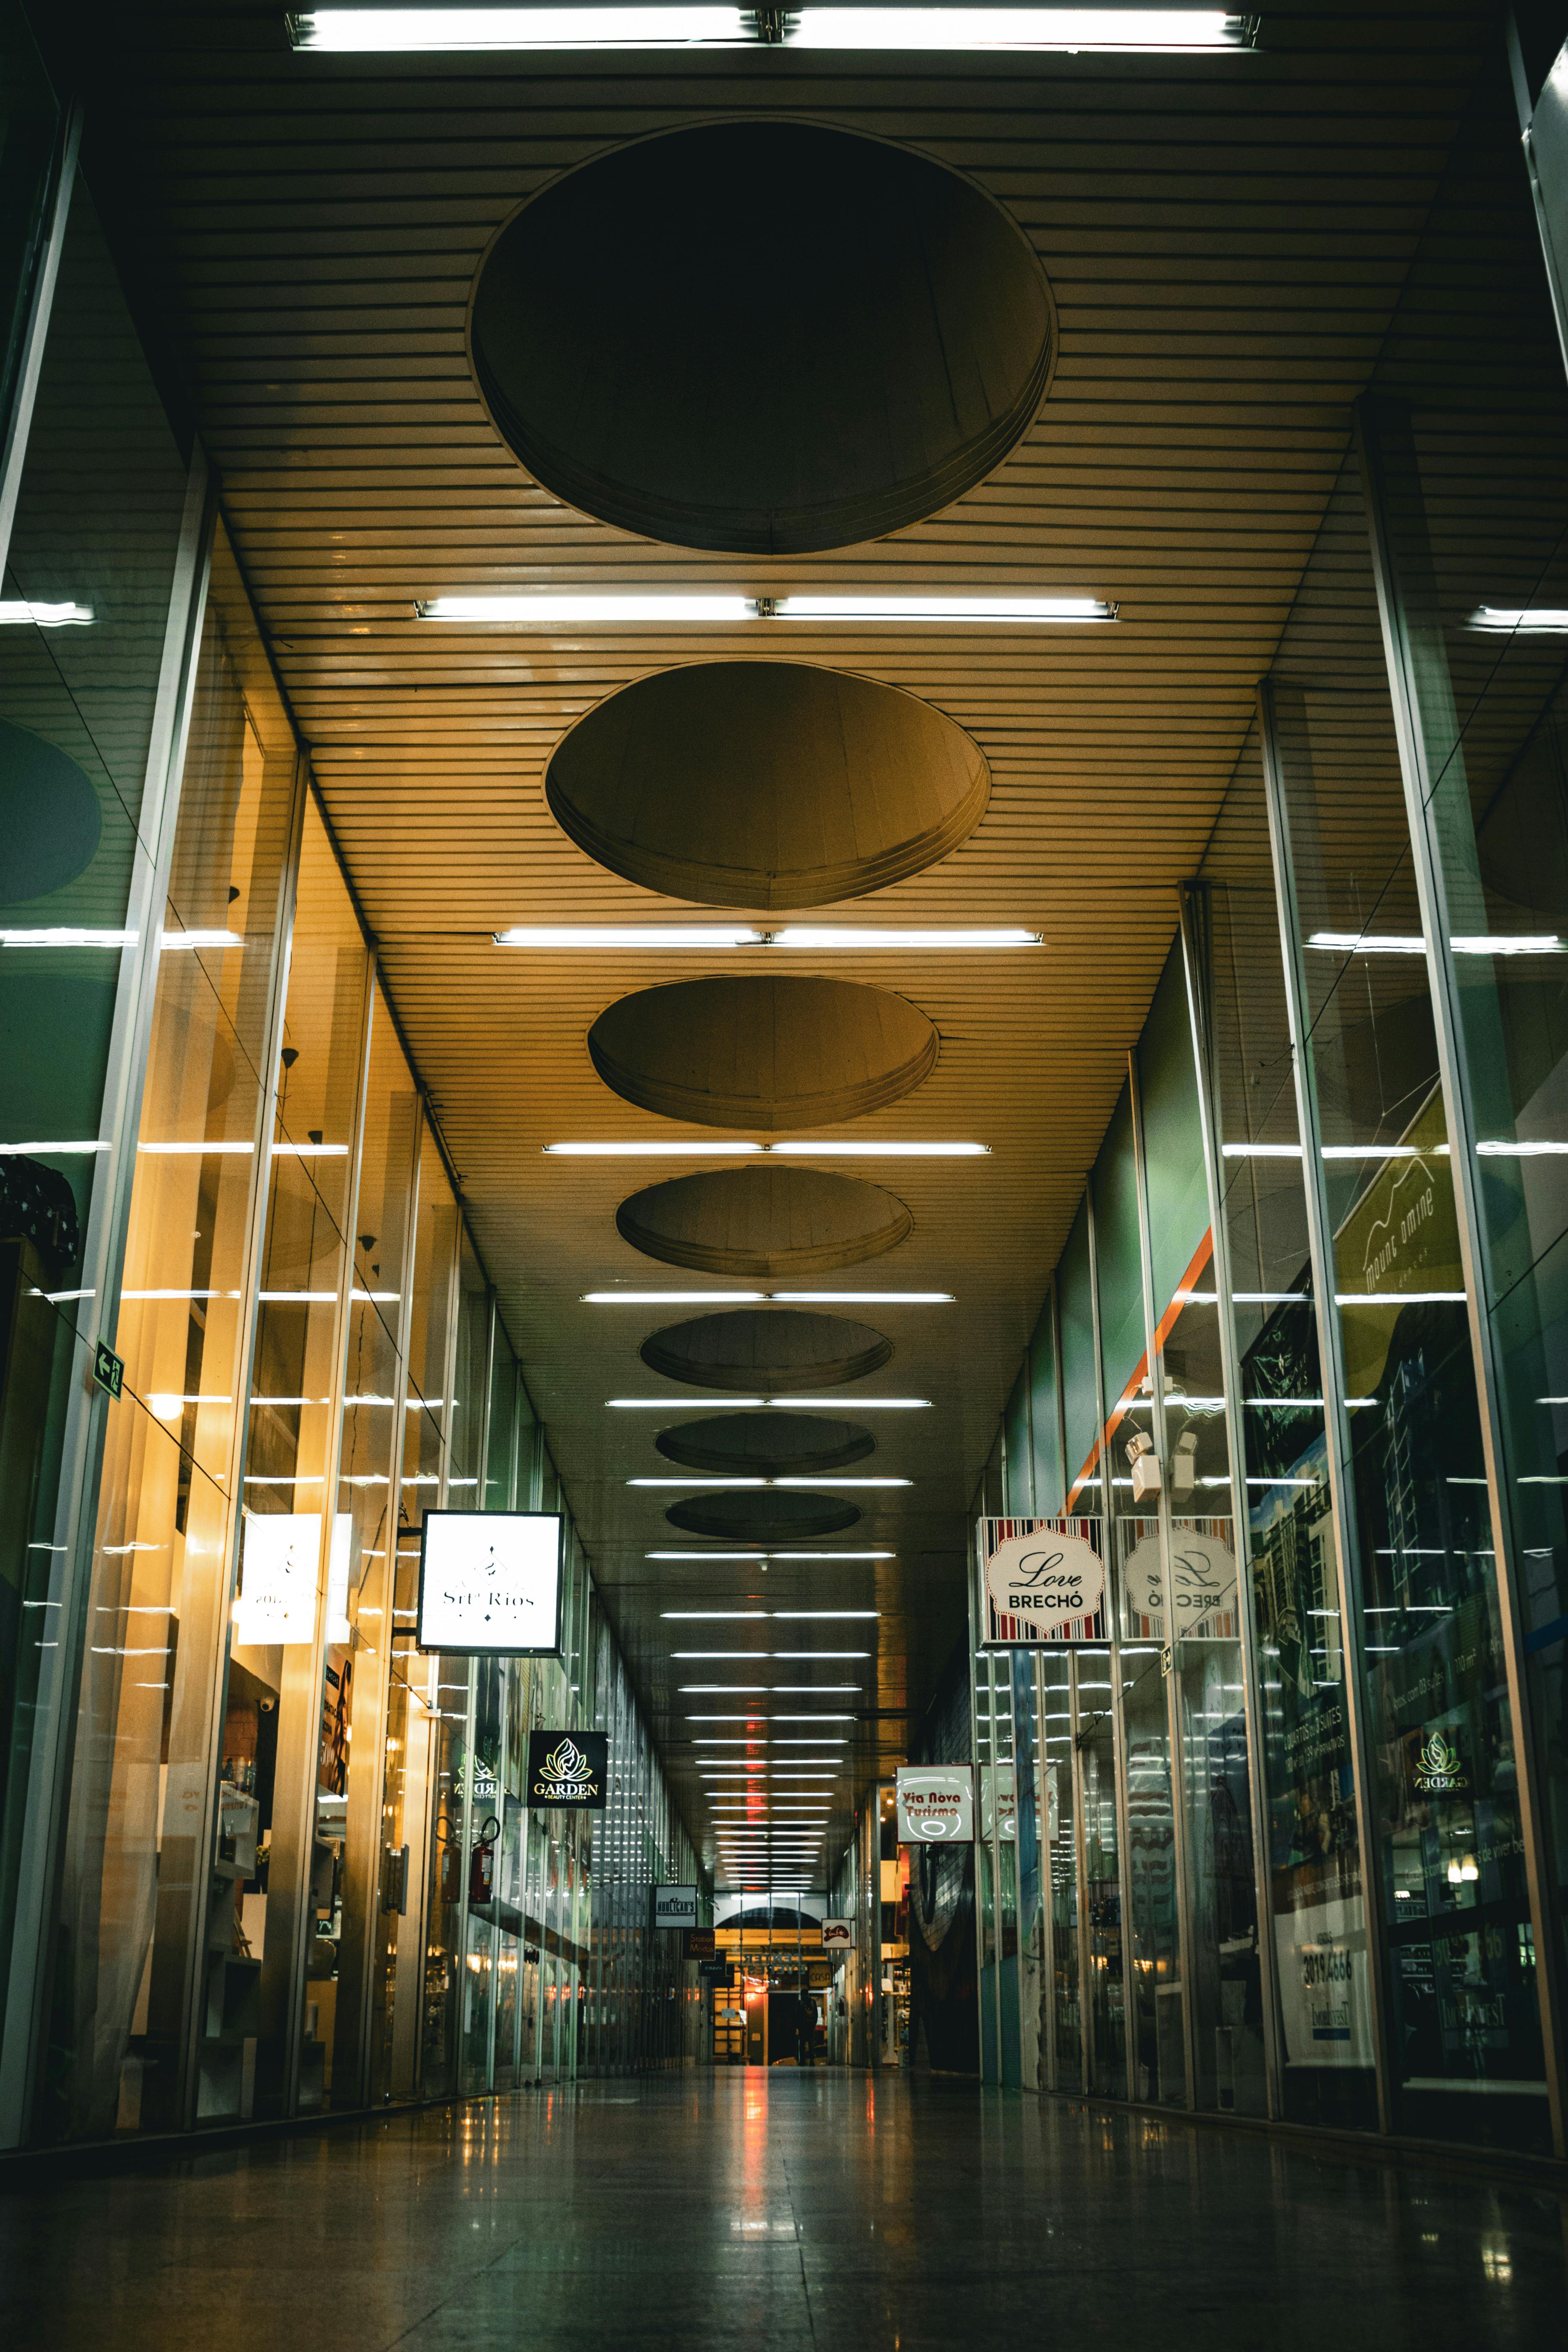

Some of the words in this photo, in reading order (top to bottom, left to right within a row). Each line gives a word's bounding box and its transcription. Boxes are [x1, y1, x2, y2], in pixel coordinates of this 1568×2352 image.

[1008, 1552, 1083, 1587] Love
[489, 1592, 534, 1606] Rios
[1009, 1591, 1083, 1608] BRECHÓ
[534, 1783, 599, 1796] GARDEN
[903, 1792, 924, 1803] Via
[929, 1792, 961, 1803] Nova
[906, 1805, 958, 1817] Turismo
[810, 1973, 831, 1981] CASA
